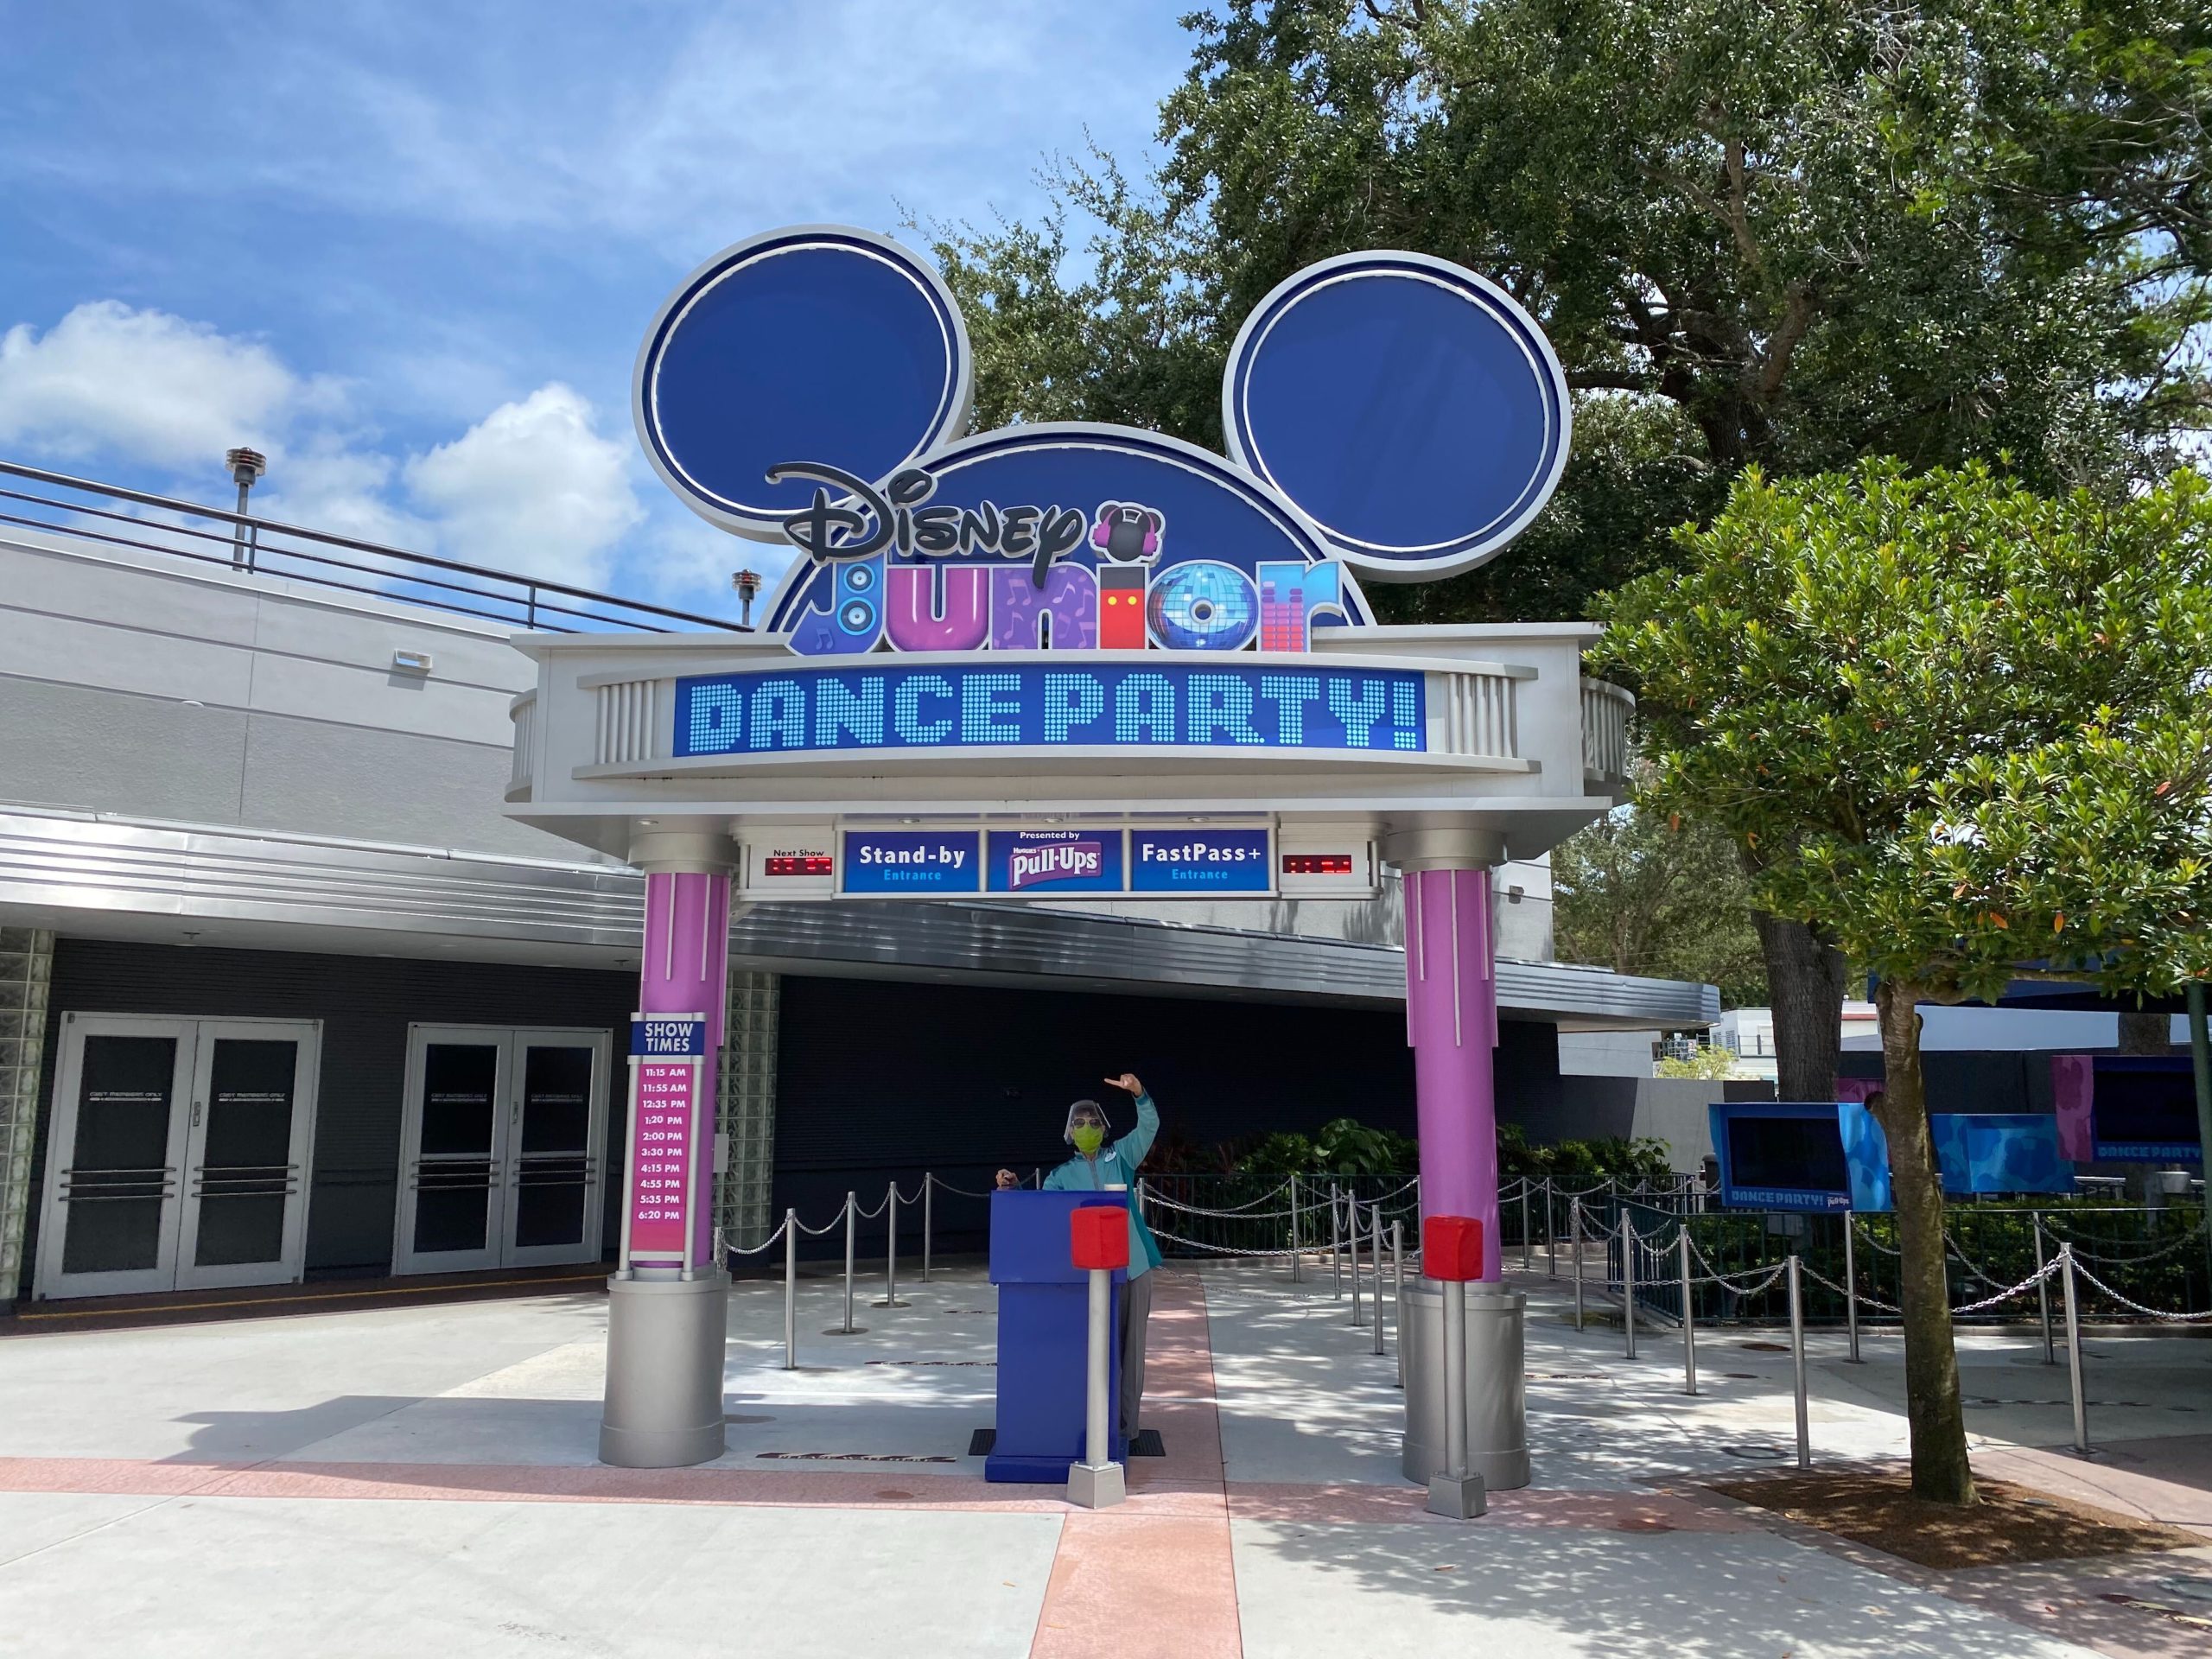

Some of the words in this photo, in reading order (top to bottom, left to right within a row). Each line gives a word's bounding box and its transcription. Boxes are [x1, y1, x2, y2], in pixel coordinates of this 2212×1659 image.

[783, 557, 1343, 655] Junior
[689, 673, 1021, 753] DANCE
[1043, 671, 1417, 750] PARTY!
[860, 846, 965, 868] Stand-by
[1142, 843, 1262, 861] FastPass+
[884, 869, 941, 880] Entrance
[1172, 869, 1228, 880] Entrance
[645, 1023, 694, 1037] SHOW
[646, 1038, 690, 1052] TIMES
[645, 1068, 665, 1077] 11:15
[669, 1068, 686, 1077] AM
[642, 1084, 668, 1092] 11:55
[670, 1084, 687, 1092] AM
[645, 1116, 664, 1125] 1:20
[667, 1116, 682, 1125] PM
[2097, 1147, 2150, 1157] DANCE
[640, 1164, 662, 1173] 4:15
[664, 1164, 680, 1173] PM
[640, 1179, 662, 1188] 4:55
[664, 1179, 680, 1188] PM
[640, 1195, 661, 1204] 5:35
[664, 1195, 680, 1204] PM
[1732, 1191, 1775, 1203] DANCE
[1776, 1192, 1824, 1206] PARTY!
[638, 1211, 661, 1219] 6:20
[664, 1211, 680, 1219] PM
